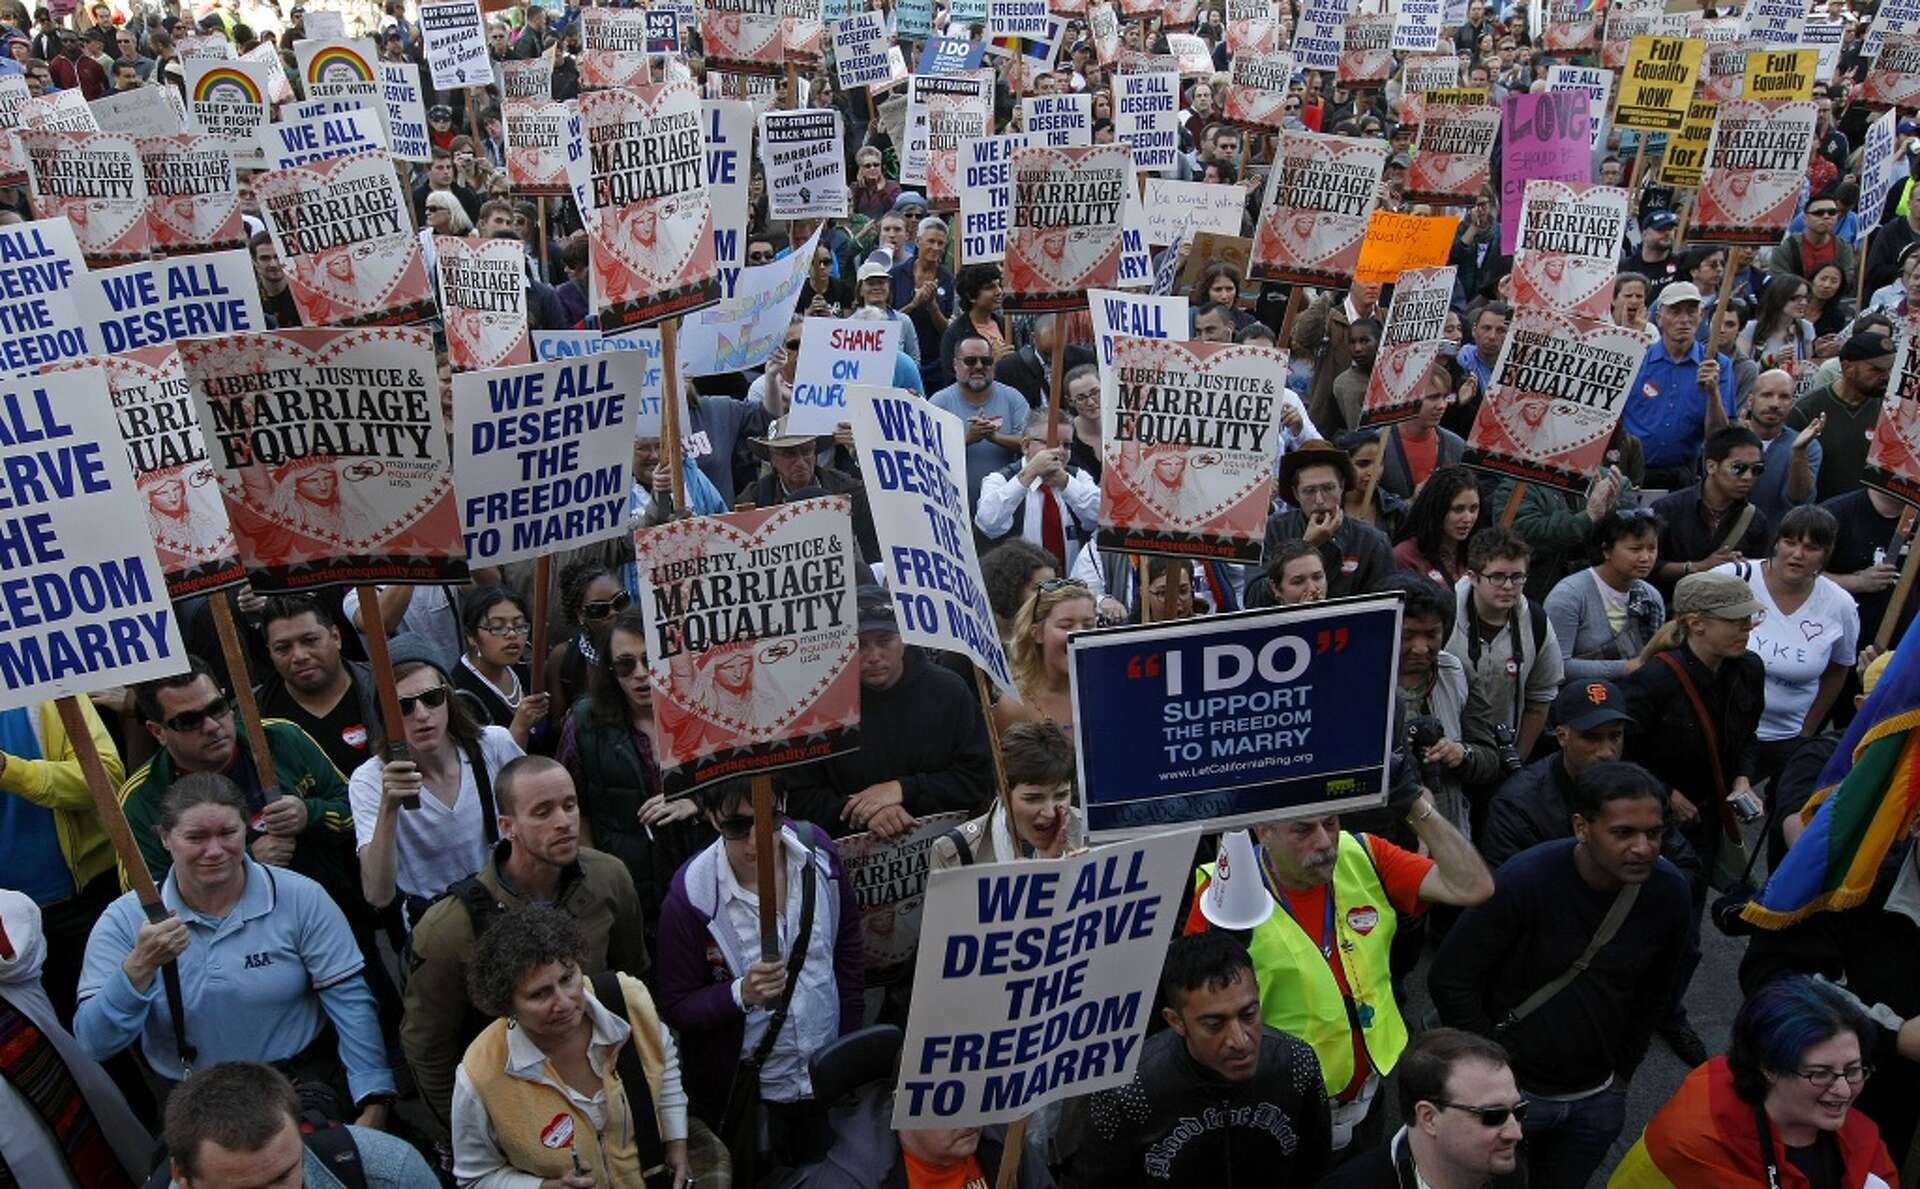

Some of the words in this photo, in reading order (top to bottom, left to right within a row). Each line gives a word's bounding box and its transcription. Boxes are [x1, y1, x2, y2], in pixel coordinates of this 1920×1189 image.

[651, 14, 674, 28] NO
[992, 2, 1046, 17] FREEDOM
[1411, 15, 1426, 25] THE
[1759, 5, 1805, 19] DESERVE
[585, 24, 643, 40] MARRIAGE
[837, 27, 883, 44] DESERVE
[838, 19, 855, 33] WE
[856, 15, 877, 31] ALL
[991, 19, 1005, 32] TO
[1006, 18, 1048, 32] MARRY
[1315, 24, 1334, 37] THE
[1395, 25, 1437, 38] FREEDOM
[1769, 18, 1788, 31] THE
[431, 28, 479, 50] MARRIAGE
[585, 38, 643, 51] EQUALITY
[1296, 37, 1341, 52] FREEDOM
[1404, 37, 1438, 48] MARRY
[1751, 29, 1799, 44] FREEDOM
[851, 41, 871, 57] THE
[1649, 39, 1683, 61] Full
[839, 53, 888, 72] FREEDOM
[1233, 60, 1289, 80] MARRIAGE
[1633, 59, 1689, 84] Equality
[1766, 53, 1797, 73] Full
[840, 73, 856, 86] TO
[856, 66, 891, 83] MARRY
[1126, 78, 1144, 94] WE
[1146, 77, 1169, 93] ALL
[1232, 74, 1287, 94] EQUALITY
[1559, 69, 1578, 84] WE
[1579, 70, 1602, 85] ALL
[1752, 73, 1806, 92] Equality
[310, 85, 344, 97] SLEEP
[346, 83, 378, 96] WITH
[1426, 91, 1485, 106] Marriage
[1635, 86, 1673, 107] NOW!
[194, 104, 229, 116] SLEEP
[231, 104, 264, 116] WITH
[1033, 100, 1054, 114] WE
[1056, 100, 1079, 113] ALL
[1120, 96, 1173, 114] DESERVE
[198, 115, 220, 127] THE
[223, 115, 260, 128] RIGHT
[207, 125, 253, 138] PEOPLE
[589, 121, 645, 143] LIBERTY,
[648, 114, 687, 135] JUSTICE
[1029, 115, 1085, 131] DESERVE
[1135, 113, 1156, 131] THE
[1421, 124, 1493, 142] MARRIAGE
[279, 124, 320, 153] WE
[323, 118, 366, 144] ALL
[1046, 132, 1069, 146] THE
[1714, 129, 1810, 151] MARRIAGE
[590, 130, 701, 175] MARRIAGE
[773, 140, 833, 166] MARRIAGE
[973, 140, 998, 163] WE
[1134, 149, 1175, 166] MARRY
[1418, 139, 1490, 156] EQUALITY
[1668, 146, 1693, 166] for
[1709, 148, 1806, 170] EQUALITY
[31, 160, 133, 179] MARRIAGE
[142, 158, 231, 181] MARRIAGE
[774, 172, 802, 190] CIVIL
[803, 162, 840, 182] RIGHT!
[1017, 168, 1068, 184] LIBERTY,
[1069, 168, 1114, 183] JUSTICE
[1330, 162, 1366, 178] JUSTICE
[37, 177, 134, 199] EQUALITY
[145, 175, 232, 198] EQUALITY
[591, 161, 702, 209] EQUALITY
[1015, 180, 1123, 205] MARRIAGE
[1277, 167, 1376, 197] MARRIAGE
[264, 189, 323, 212] LIBERTY,
[327, 177, 379, 199] JUSTICE
[1273, 188, 1371, 217] EQUALITY
[271, 187, 399, 234] MARRIAGE
[1013, 202, 1121, 229] EQUALITY
[1575, 203, 1613, 218] JUSTICE
[281, 208, 403, 259] EQUALITY
[1524, 211, 1619, 237] MARRIAGE
[0, 229, 55, 263] ALL
[1521, 229, 1617, 257] EQUALITY
[101, 270, 161, 312] WE
[168, 263, 229, 300] ALL
[442, 268, 520, 291] MARRIAGE
[445, 289, 520, 313] EQUALITY
[0, 300, 53, 334] THE
[99, 299, 251, 354] DESERVE
[1105, 298, 1130, 331] WE
[1131, 303, 1168, 339] ALL
[830, 328, 886, 351] SHAME
[1514, 329, 1570, 355] LIBERTY,
[1573, 342, 1625, 367] JUSTICE
[831, 361, 861, 380] ON
[1505, 341, 1632, 389] MARRIAGE
[202, 367, 310, 399] LIBERTY,
[314, 365, 405, 388] JUSTICE
[407, 367, 425, 387] &
[487, 372, 545, 414] WE
[552, 360, 615, 402] ALL
[1119, 367, 1190, 388] LIBERTY,
[1193, 373, 1261, 393] JUSTICE
[1497, 363, 1622, 413] EQUALITY
[207, 388, 431, 433] MARRIAGE
[1116, 384, 1273, 423] MARRIAGE
[471, 393, 626, 456] DESERVE
[872, 398, 919, 445] WE
[1113, 411, 1270, 452] EQUALITY
[216, 422, 433, 471] EQUALITY
[517, 440, 580, 482] THE
[465, 464, 623, 529] FREEDOM
[464, 530, 501, 561] TO
[512, 496, 628, 553] MARRY
[924, 503, 965, 563] THE
[650, 551, 743, 588] LIBERTY,
[747, 536, 827, 570] JUSTICE
[827, 534, 844, 553] &
[652, 555, 847, 624] MARRIAGE
[896, 592, 940, 634] TO
[654, 590, 848, 661] EQUALITY
[0, 609, 170, 690] MARRY
[1163, 685, 1314, 724] SUPPORT
[1162, 723, 1204, 742] THE
[1210, 709, 1312, 737] FREEDOM
[1163, 742, 1202, 765] TO
[1211, 727, 1312, 759] MARRY
[1157, 752, 1315, 783] www.LetCaliforniaRing.org
[976, 871, 1061, 926] WE
[1066, 850, 1150, 914] ALL
[942, 895, 1162, 981] DESERVE
[244, 953, 272, 971] ASA
[1004, 958, 1090, 1022] THE
[919, 990, 1143, 1076] FREEDOM
[904, 1079, 967, 1118] TO
[979, 1033, 1142, 1115] MARRY
